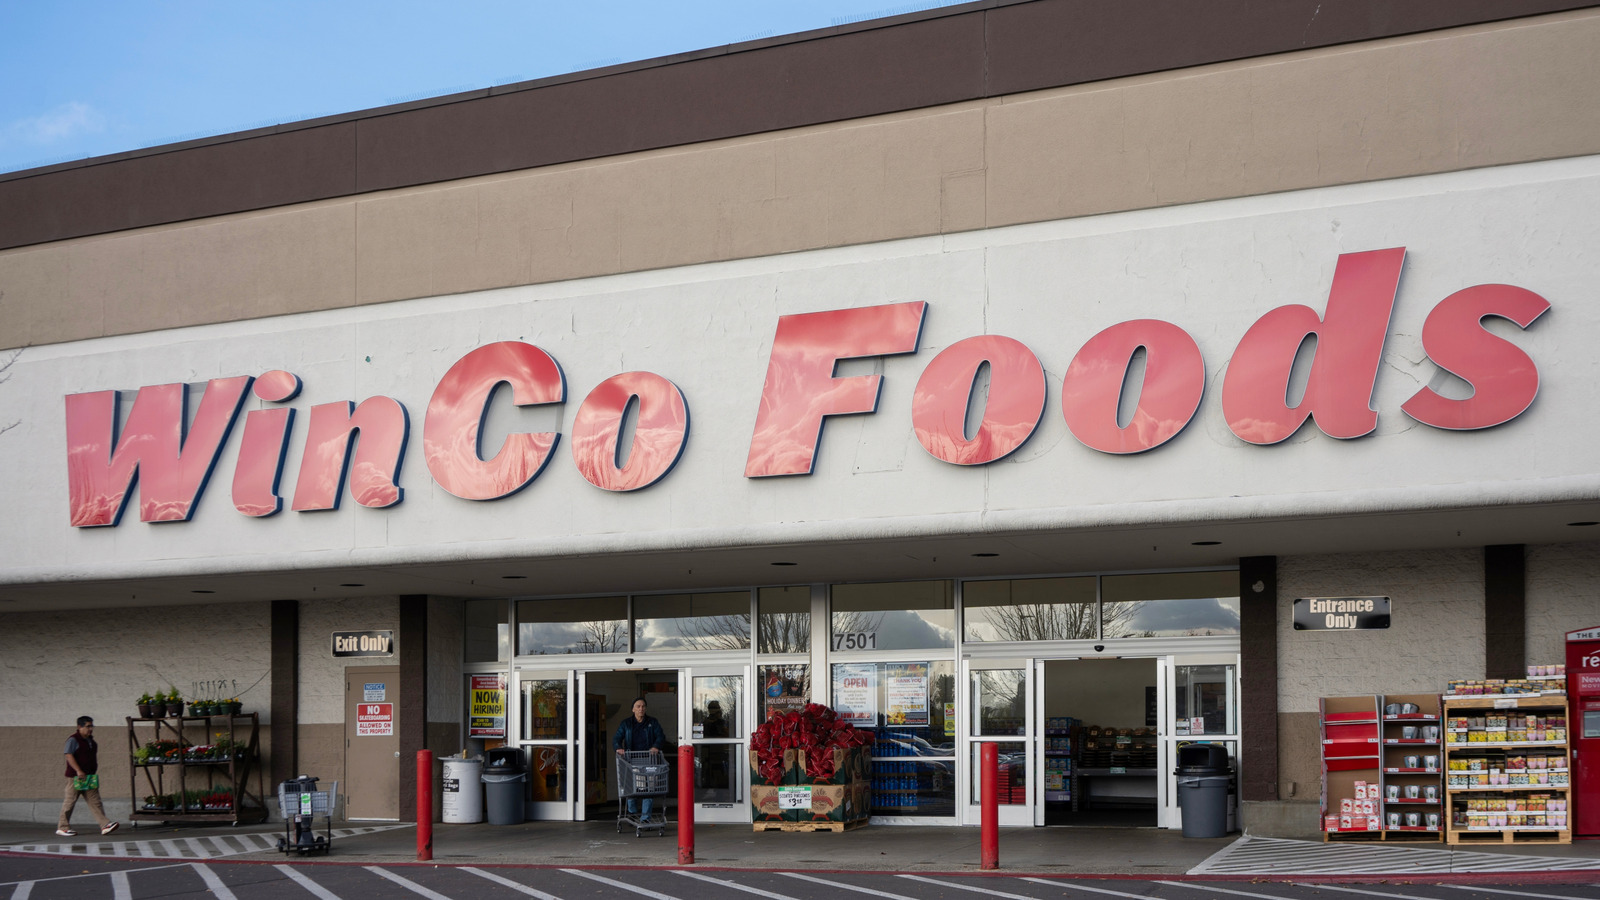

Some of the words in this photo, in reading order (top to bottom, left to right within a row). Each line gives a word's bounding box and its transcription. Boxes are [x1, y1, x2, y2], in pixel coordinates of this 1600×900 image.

[65, 340, 690, 527] WinCo
[744, 246, 1552, 480] Foods
[1310, 599, 1374, 614] Entrance
[1325, 613, 1358, 629] Only
[336, 636, 358, 652] Exit
[360, 635, 390, 652] Only
[834, 632, 876, 650] 7501
[843, 677, 868, 688] OPEN
[475, 691, 501, 704] NOW
[367, 705, 381, 715] NO
[473, 704, 502, 715] HIRING!
